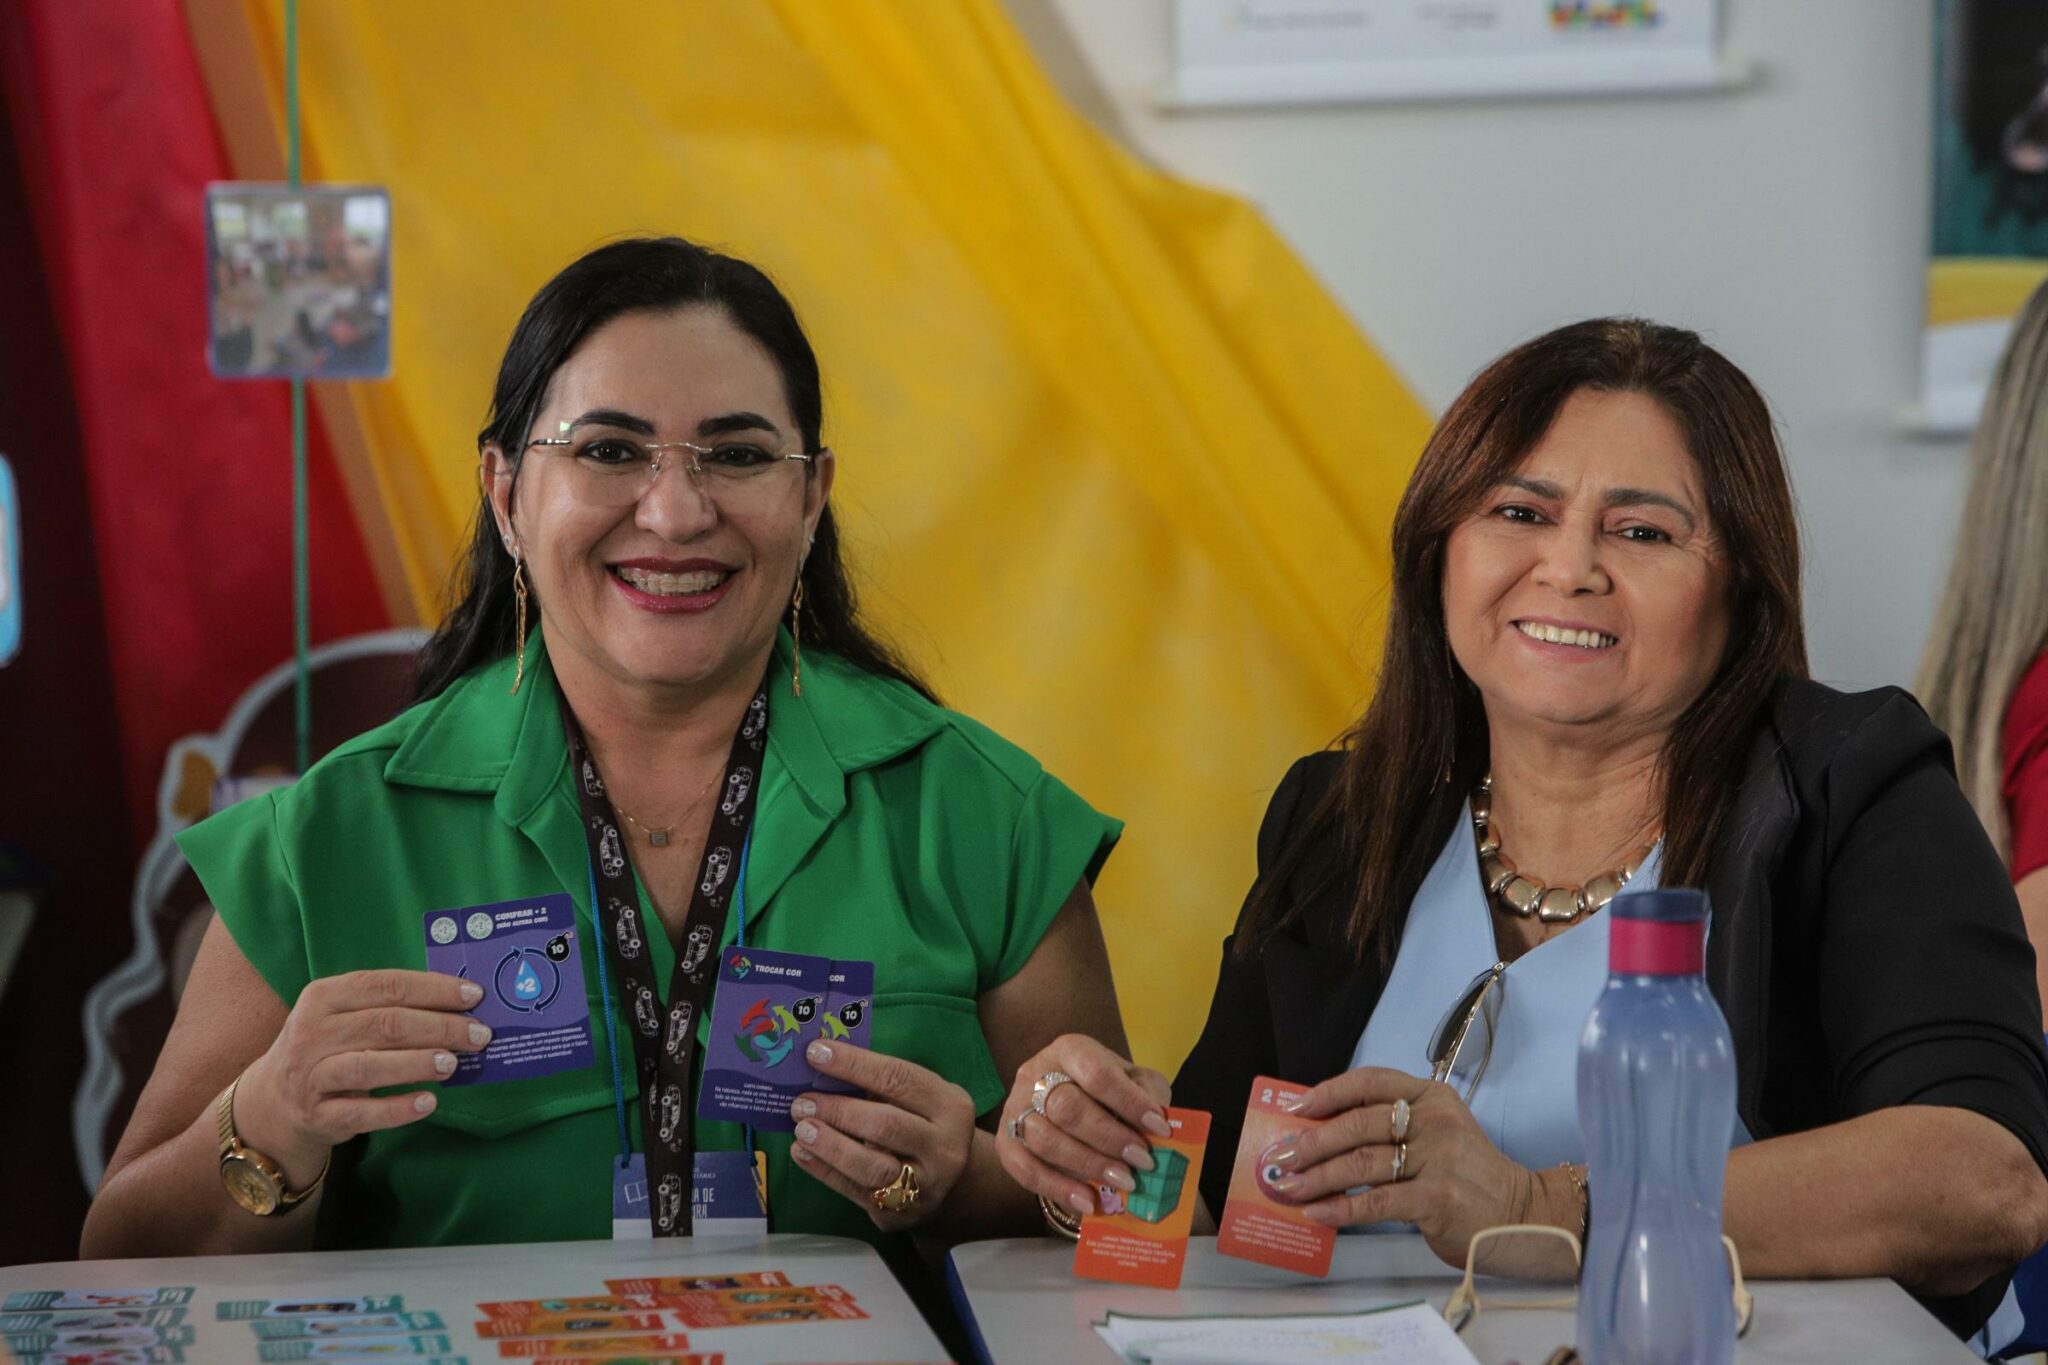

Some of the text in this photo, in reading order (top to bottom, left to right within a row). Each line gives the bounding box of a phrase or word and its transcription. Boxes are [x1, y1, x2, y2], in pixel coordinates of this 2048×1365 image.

[495, 909, 533, 921] COMPRAR
[551, 944, 564, 954] 10
[755, 964, 802, 977] TROCAR COR
[516, 978, 536, 992] +2
[798, 1006, 810, 1016] 10
[845, 1010, 858, 1020] 10
[1261, 1088, 1273, 1103] 2
[702, 1188, 714, 1202] DE
